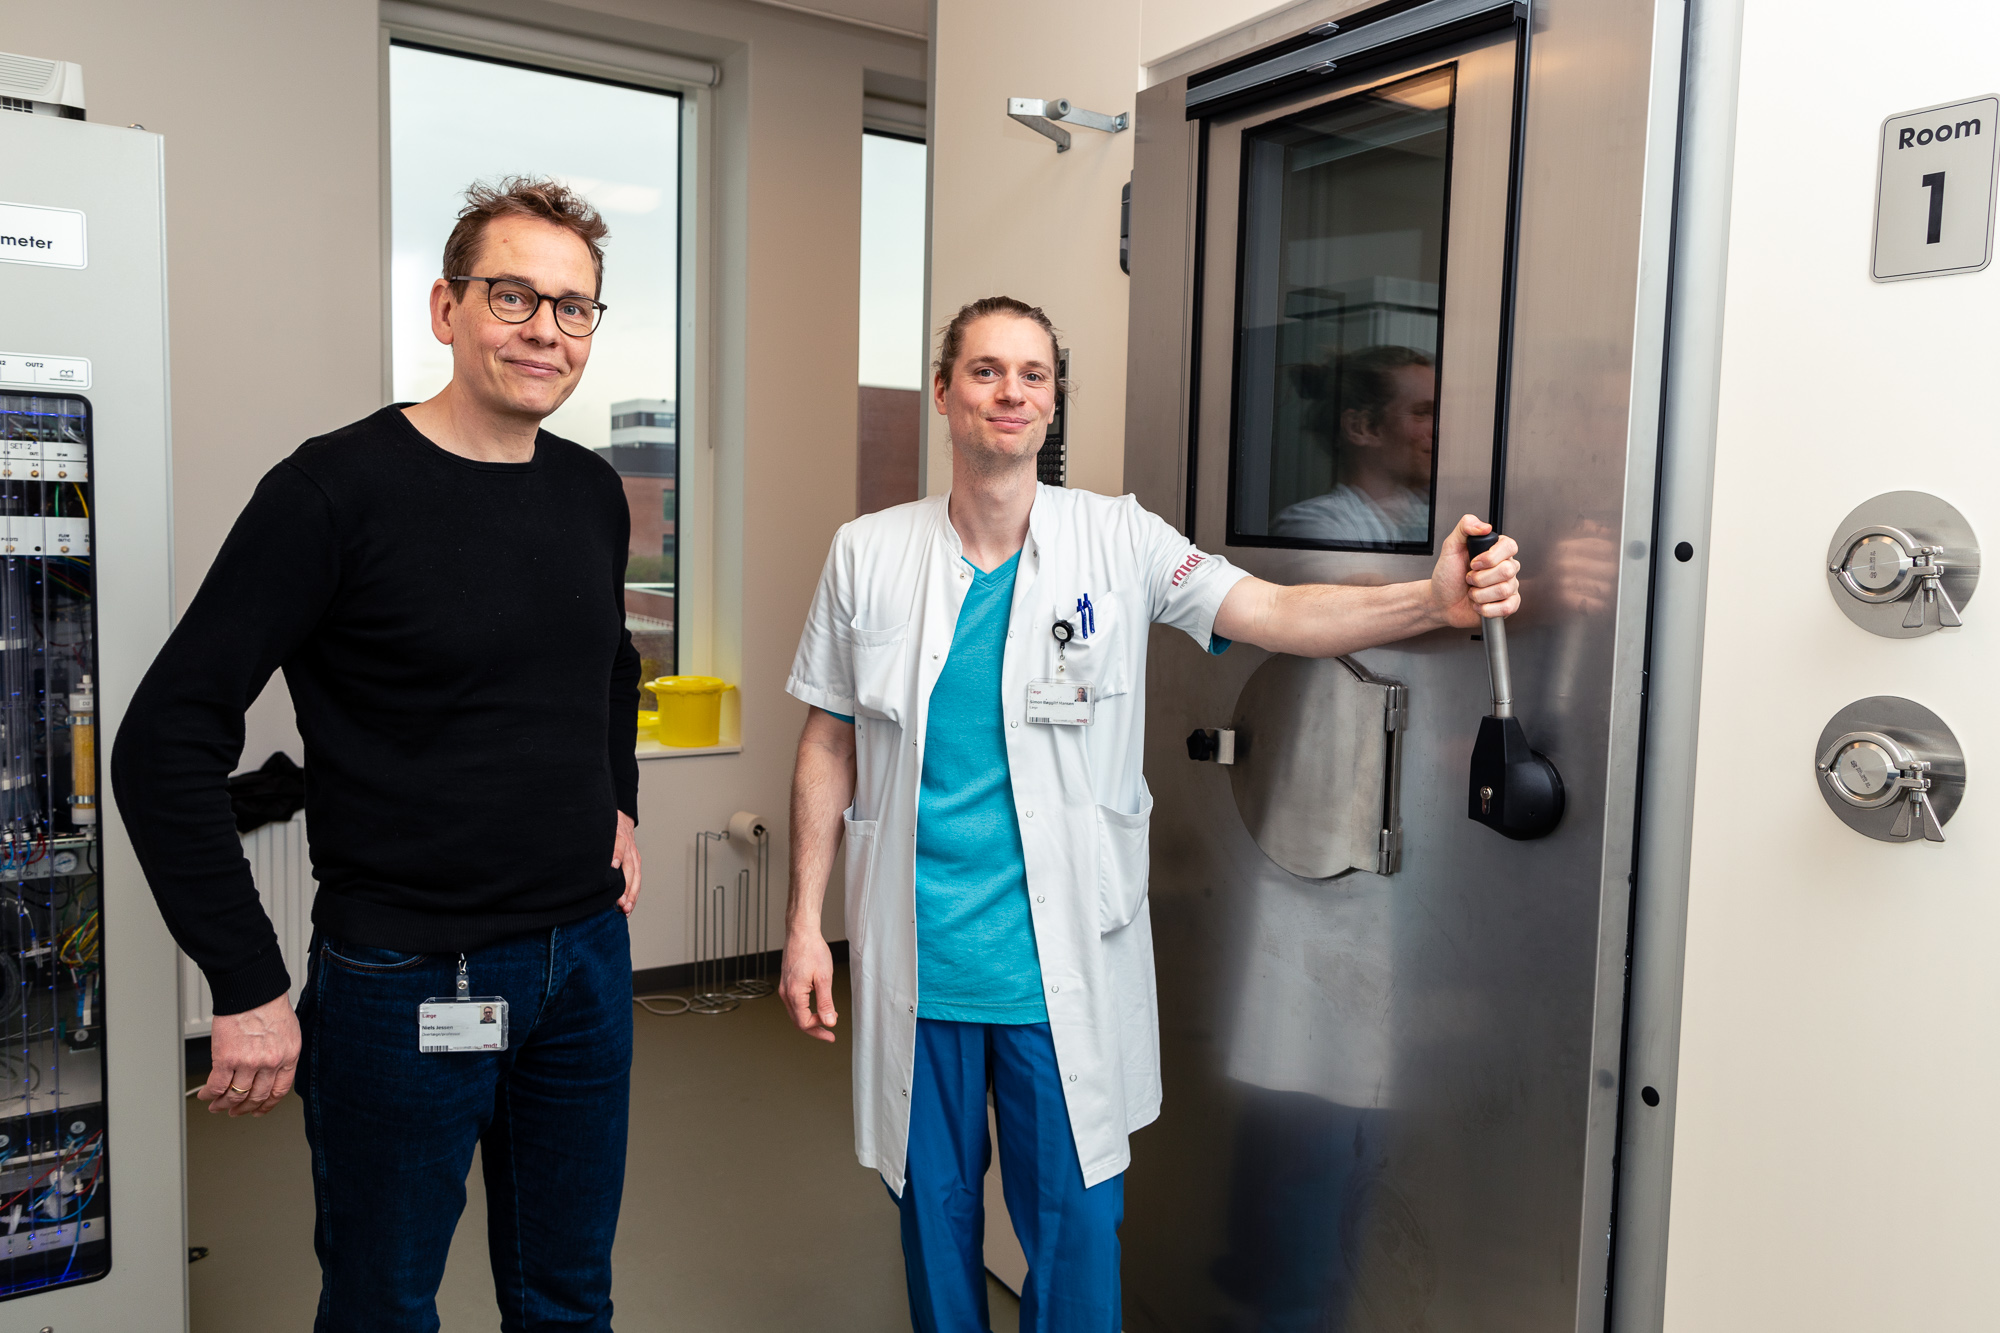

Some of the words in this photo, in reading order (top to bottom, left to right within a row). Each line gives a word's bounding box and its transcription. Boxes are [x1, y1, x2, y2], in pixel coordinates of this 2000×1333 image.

[1898, 118, 1981, 150] Room
[1921, 171, 1946, 245] 1
[0, 235, 53, 249] meter
[10, 442, 23, 450] SET
